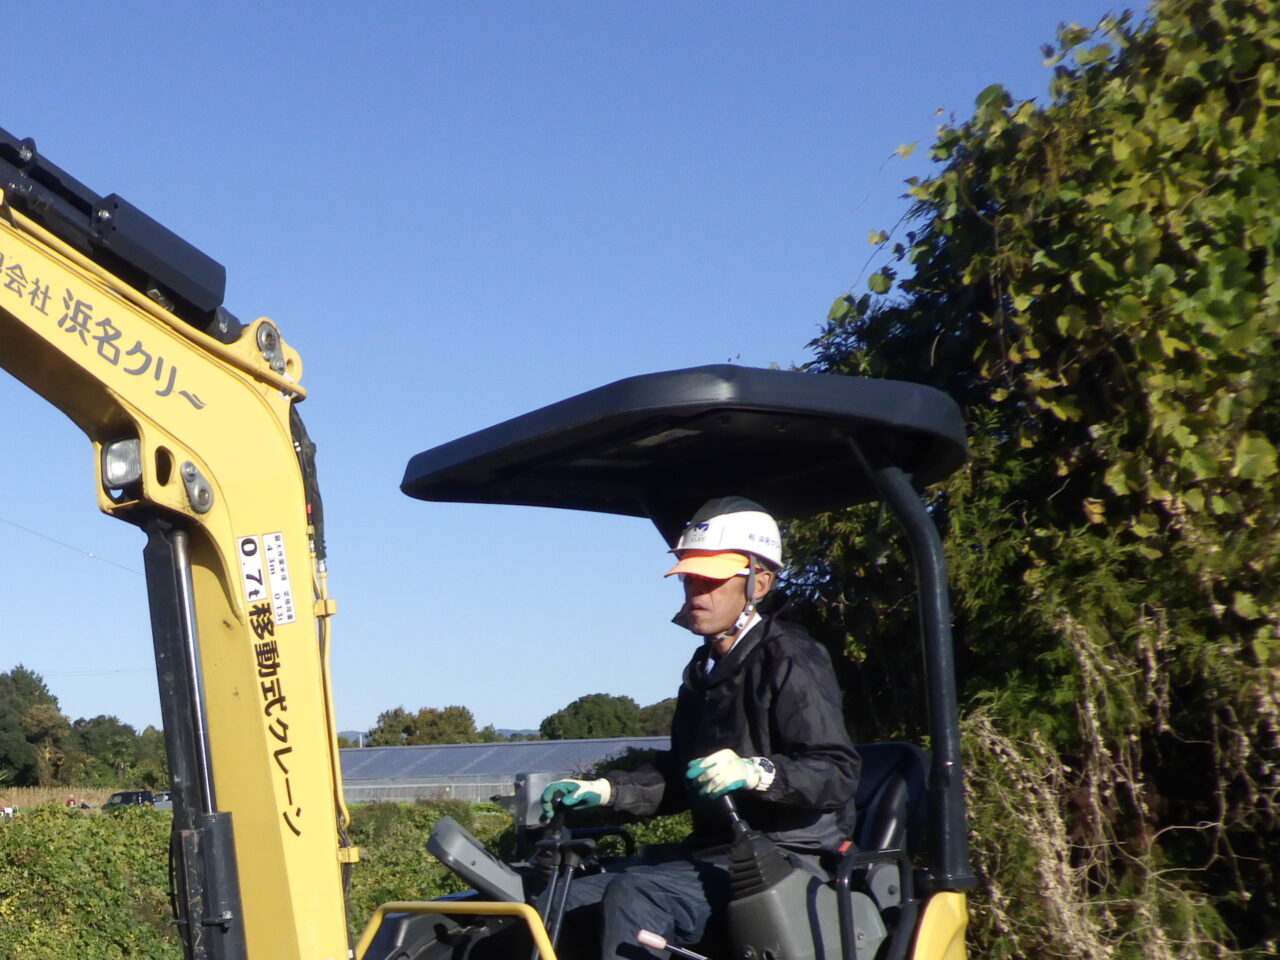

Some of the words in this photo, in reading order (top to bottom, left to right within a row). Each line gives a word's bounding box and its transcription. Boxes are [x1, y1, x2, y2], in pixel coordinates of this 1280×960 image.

[240, 537, 264, 600] 0.7t
[248, 601, 301, 837] 移動式クレーン
